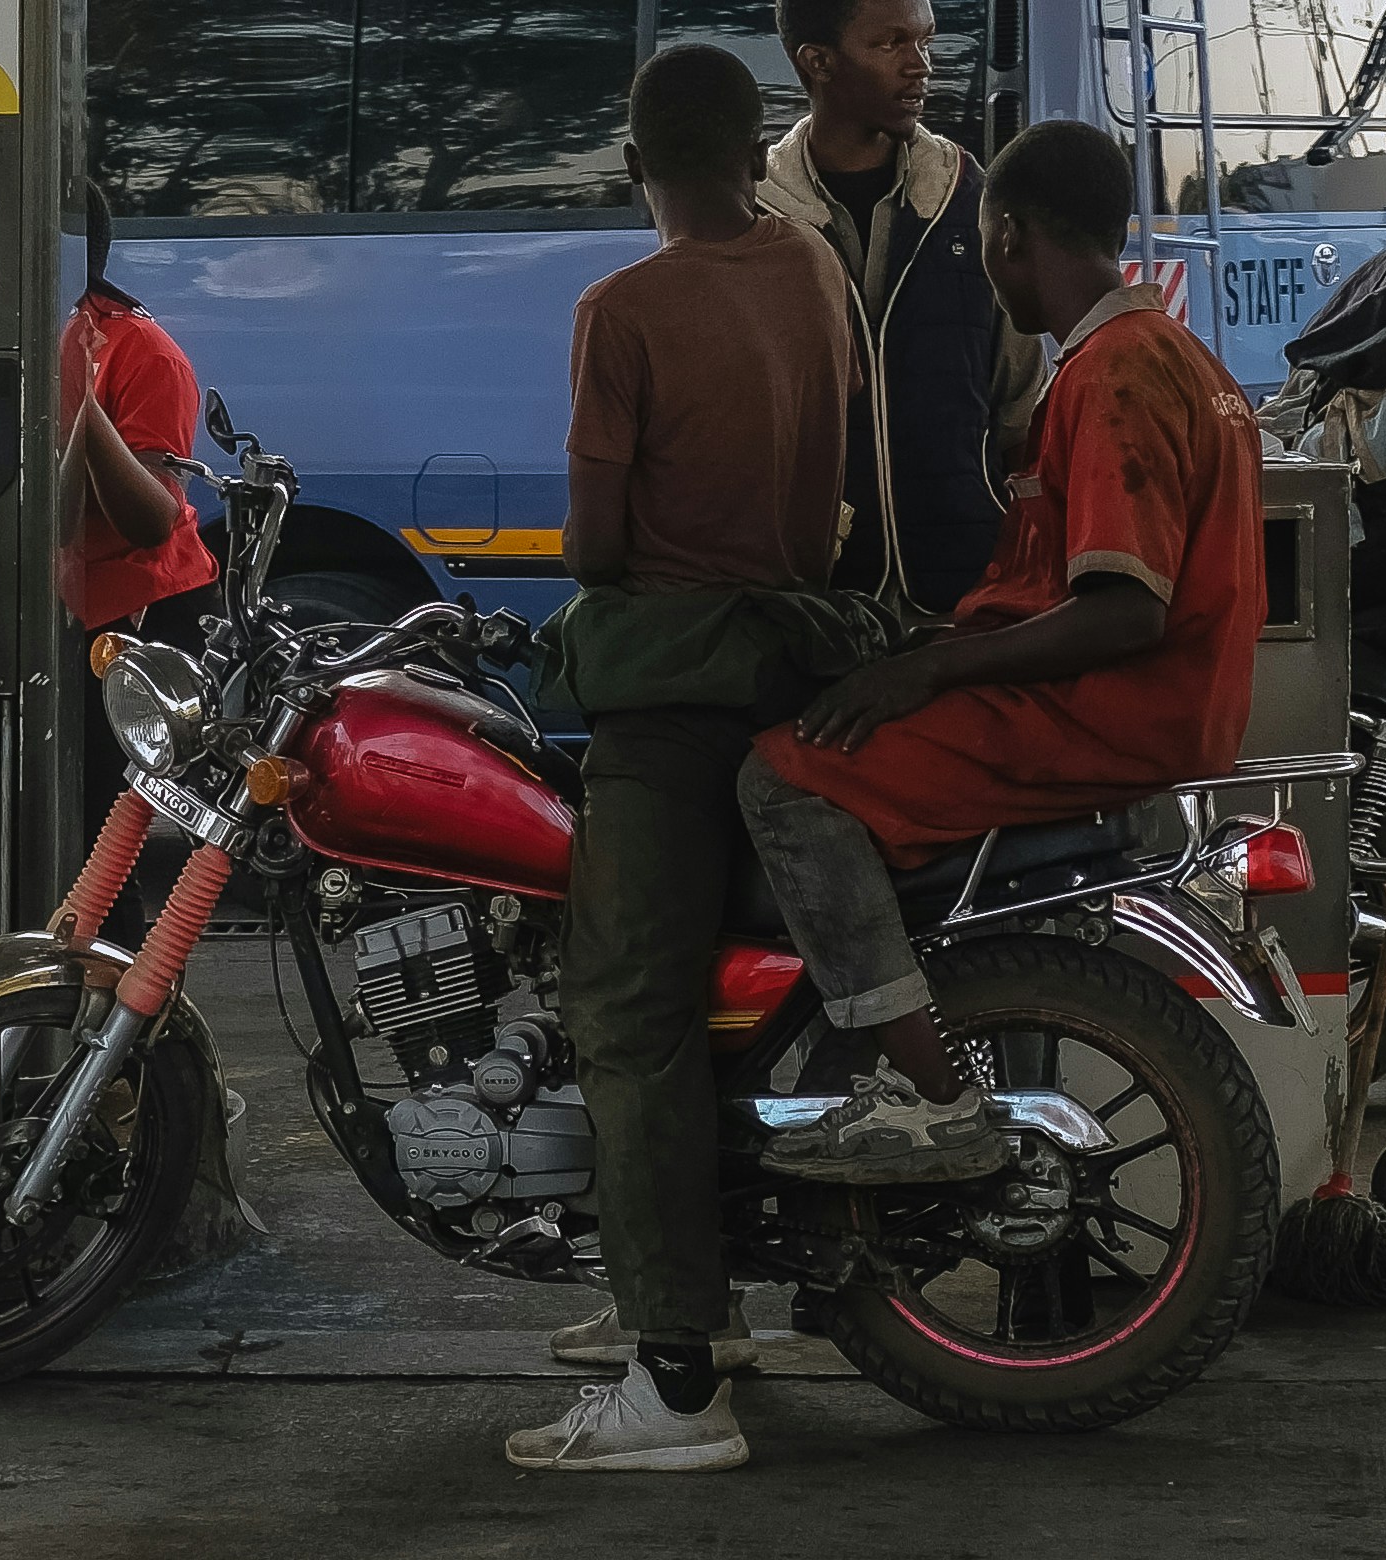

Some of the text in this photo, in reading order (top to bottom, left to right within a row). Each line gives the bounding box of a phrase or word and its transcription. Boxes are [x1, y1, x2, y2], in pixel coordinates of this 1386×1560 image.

[1222, 257, 1305, 327] STAFF
[145, 777, 190, 816] SKYGO
[422, 1148, 471, 1158] SKYGO
